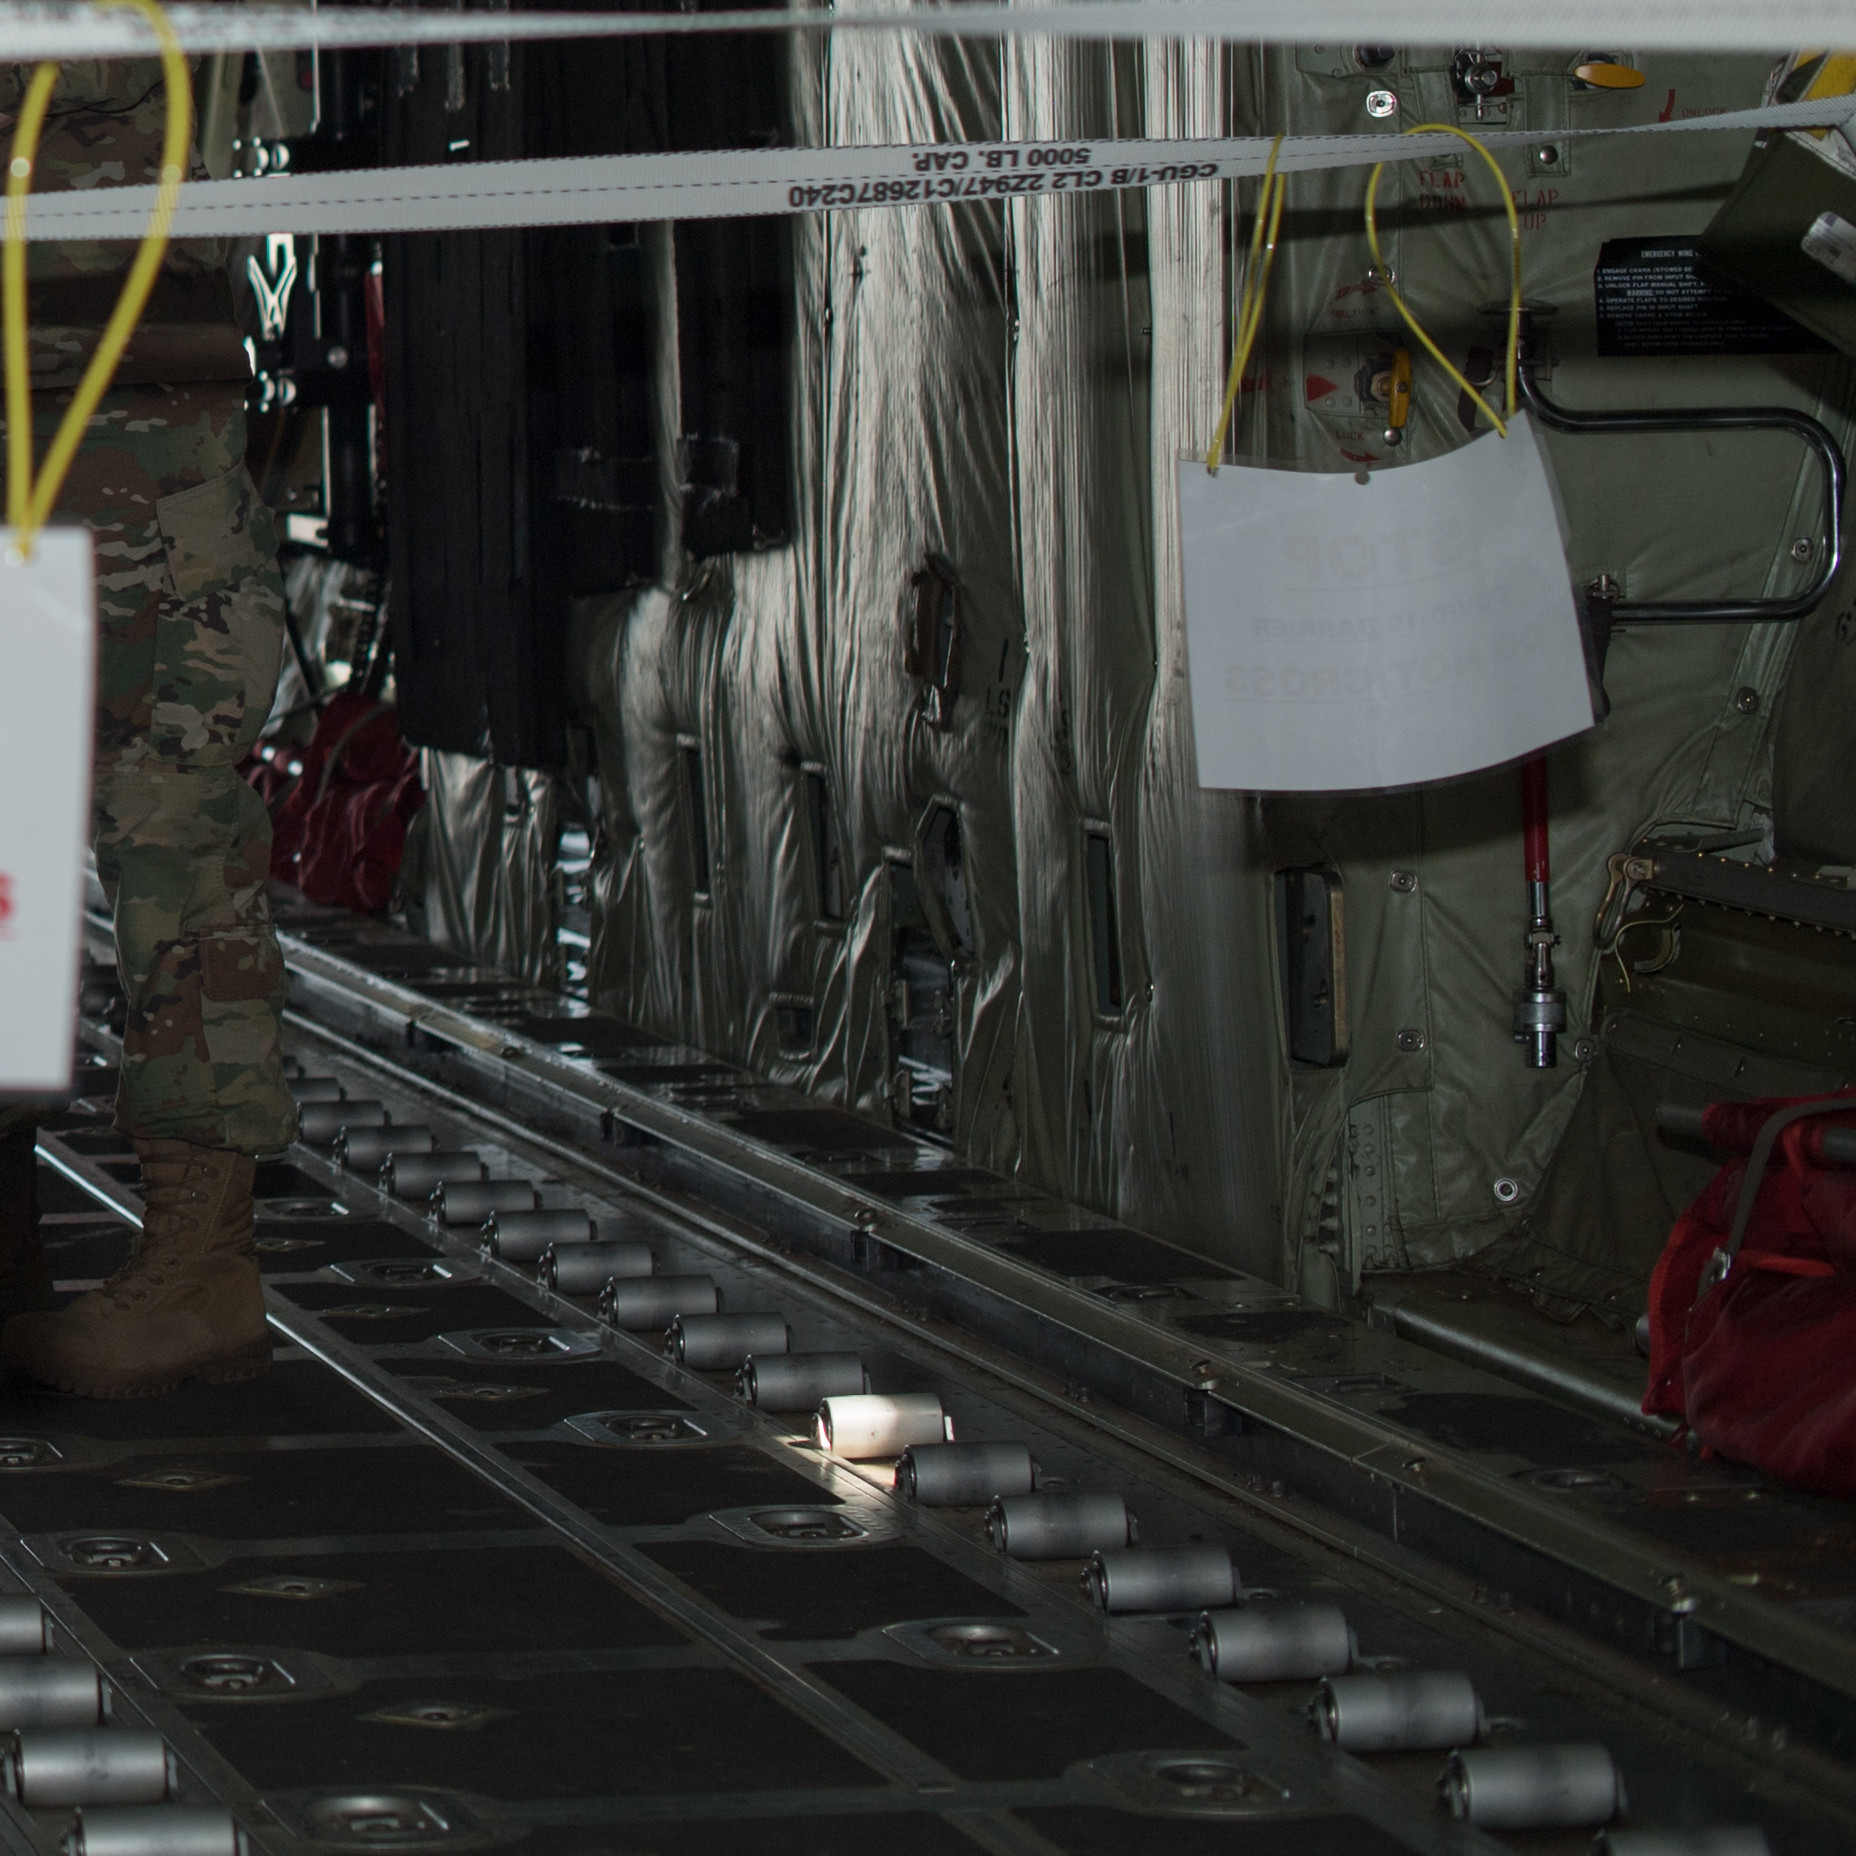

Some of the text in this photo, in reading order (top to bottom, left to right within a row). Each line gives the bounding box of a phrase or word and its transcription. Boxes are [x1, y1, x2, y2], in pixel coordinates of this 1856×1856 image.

[911, 146, 1091, 172] 5000 LB. CAP.
[1052, 169, 1102, 191] CL2
[1110, 162, 1219, 187] CGU-1/B
[1419, 171, 1465, 190] FLAP
[1511, 189, 1559, 209] FLAP
[1524, 214, 1547, 230] UP
[1641, 250, 1675, 258] EMERGENCY
